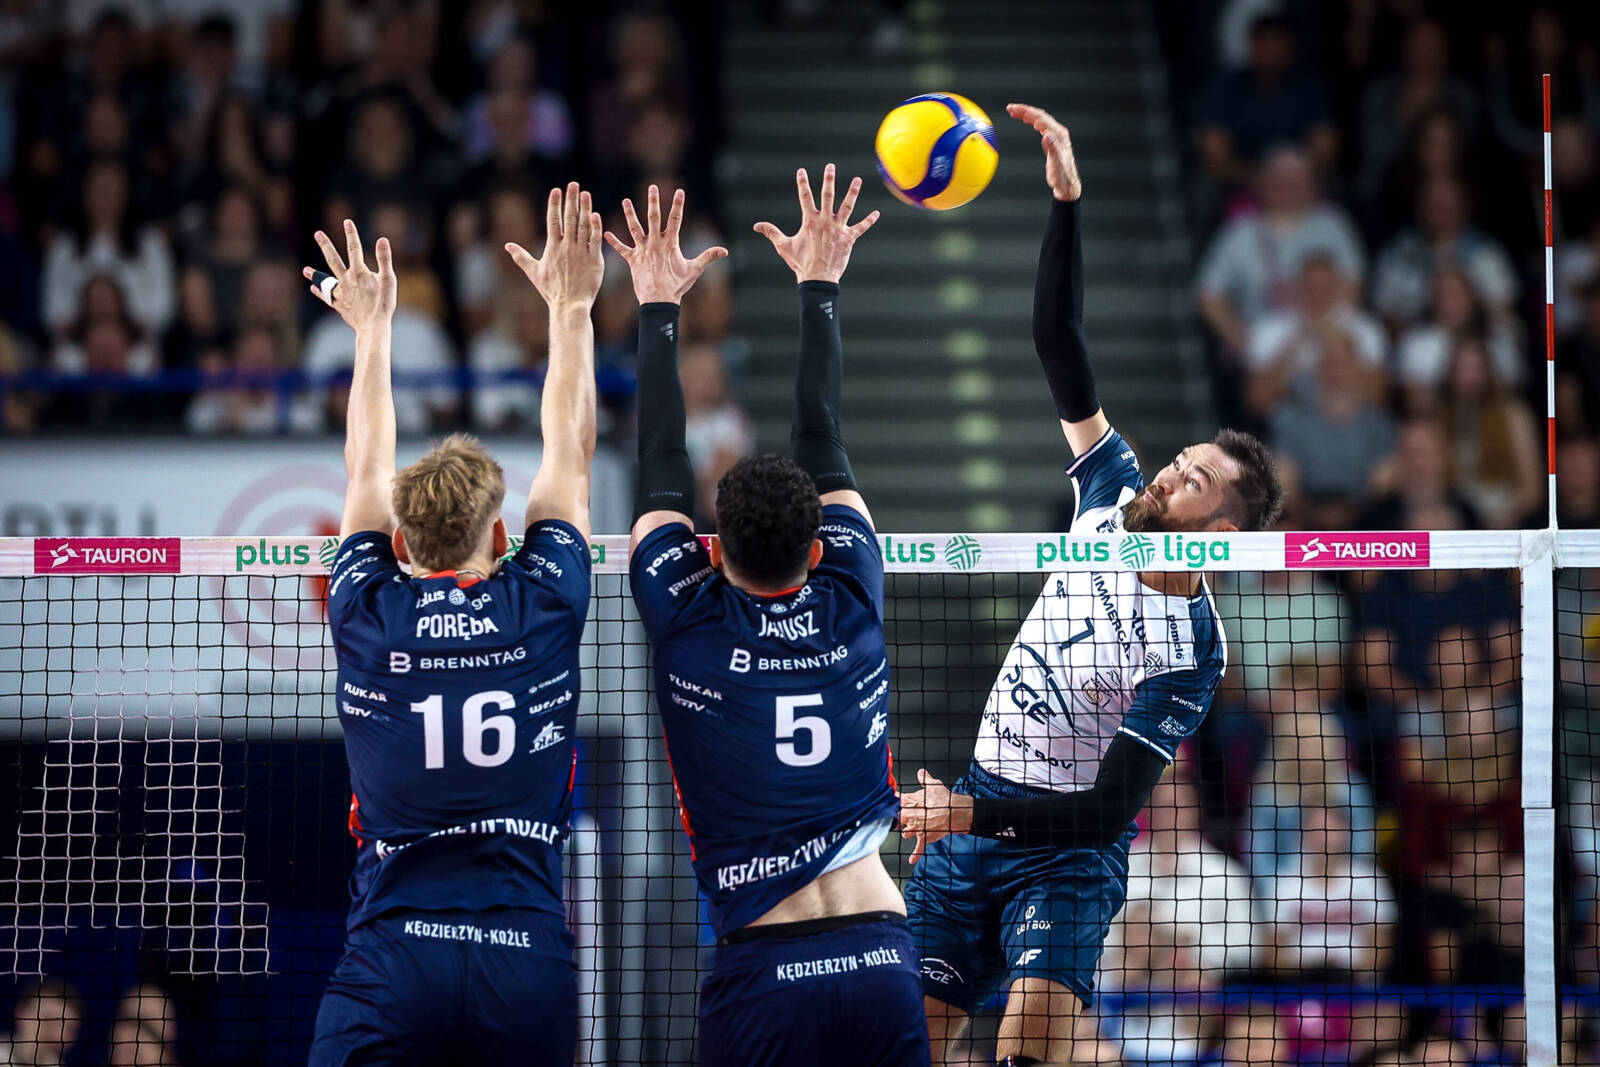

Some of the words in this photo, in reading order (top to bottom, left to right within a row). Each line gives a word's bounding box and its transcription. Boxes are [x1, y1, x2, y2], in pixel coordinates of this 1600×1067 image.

[81, 547, 167, 564] TAURON
[236, 538, 310, 572] plus
[880, 536, 936, 563] lus
[1036, 534, 1110, 569] plus
[1163, 534, 1230, 568] liga
[1331, 542, 1416, 558] TAURON
[1093, 573, 1131, 661] IMMERGA
[420, 647, 527, 670] BRENNTAG
[758, 645, 849, 671] BRENNTAG
[410, 690, 517, 770] 16
[775, 693, 832, 767] 5
[404, 920, 532, 948] KĘDZIERZYN-KOŹLE
[777, 947, 902, 982] KĘDZIERZYN-KOŹLE
